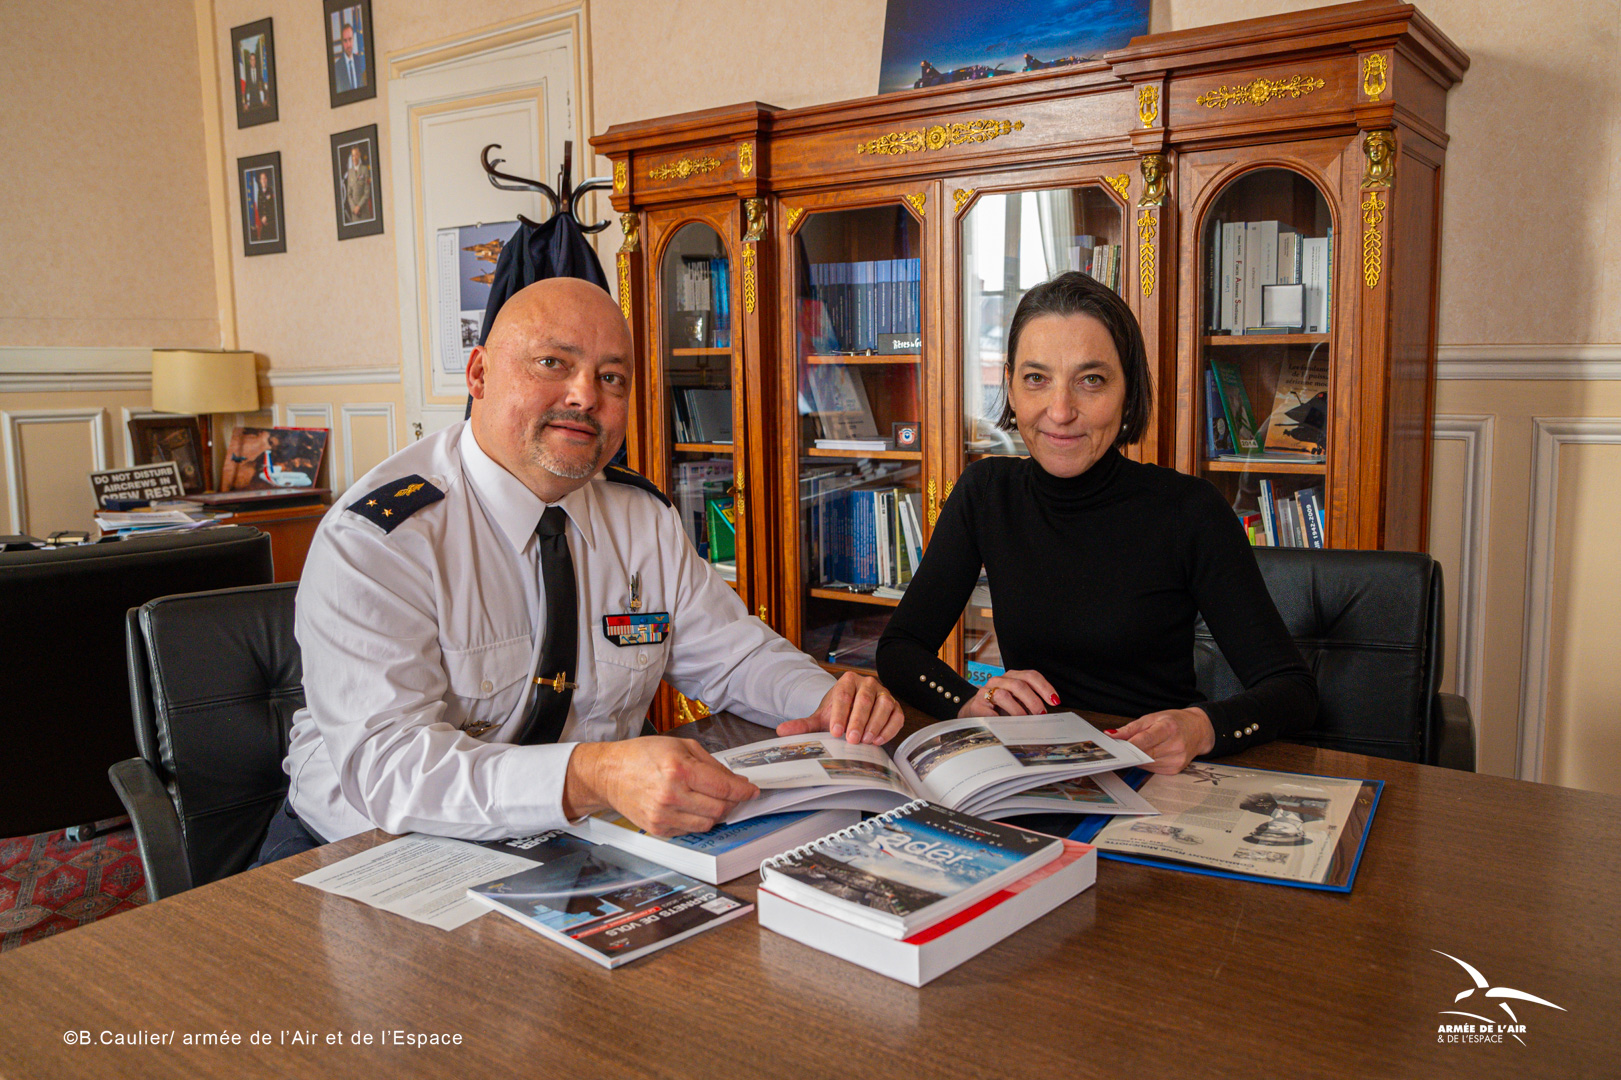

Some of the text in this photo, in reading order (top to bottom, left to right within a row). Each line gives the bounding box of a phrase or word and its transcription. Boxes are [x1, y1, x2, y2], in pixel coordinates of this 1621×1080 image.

[94, 467, 173, 485] DO NOT DISTURB
[104, 477, 171, 493] AIRCREWS IN
[144, 485, 178, 500] REST
[1306, 504, 1318, 539] 1942-2009
[659, 893, 717, 918] CARNETS
[640, 914, 660, 925] DE
[605, 922, 642, 937] VOLS
